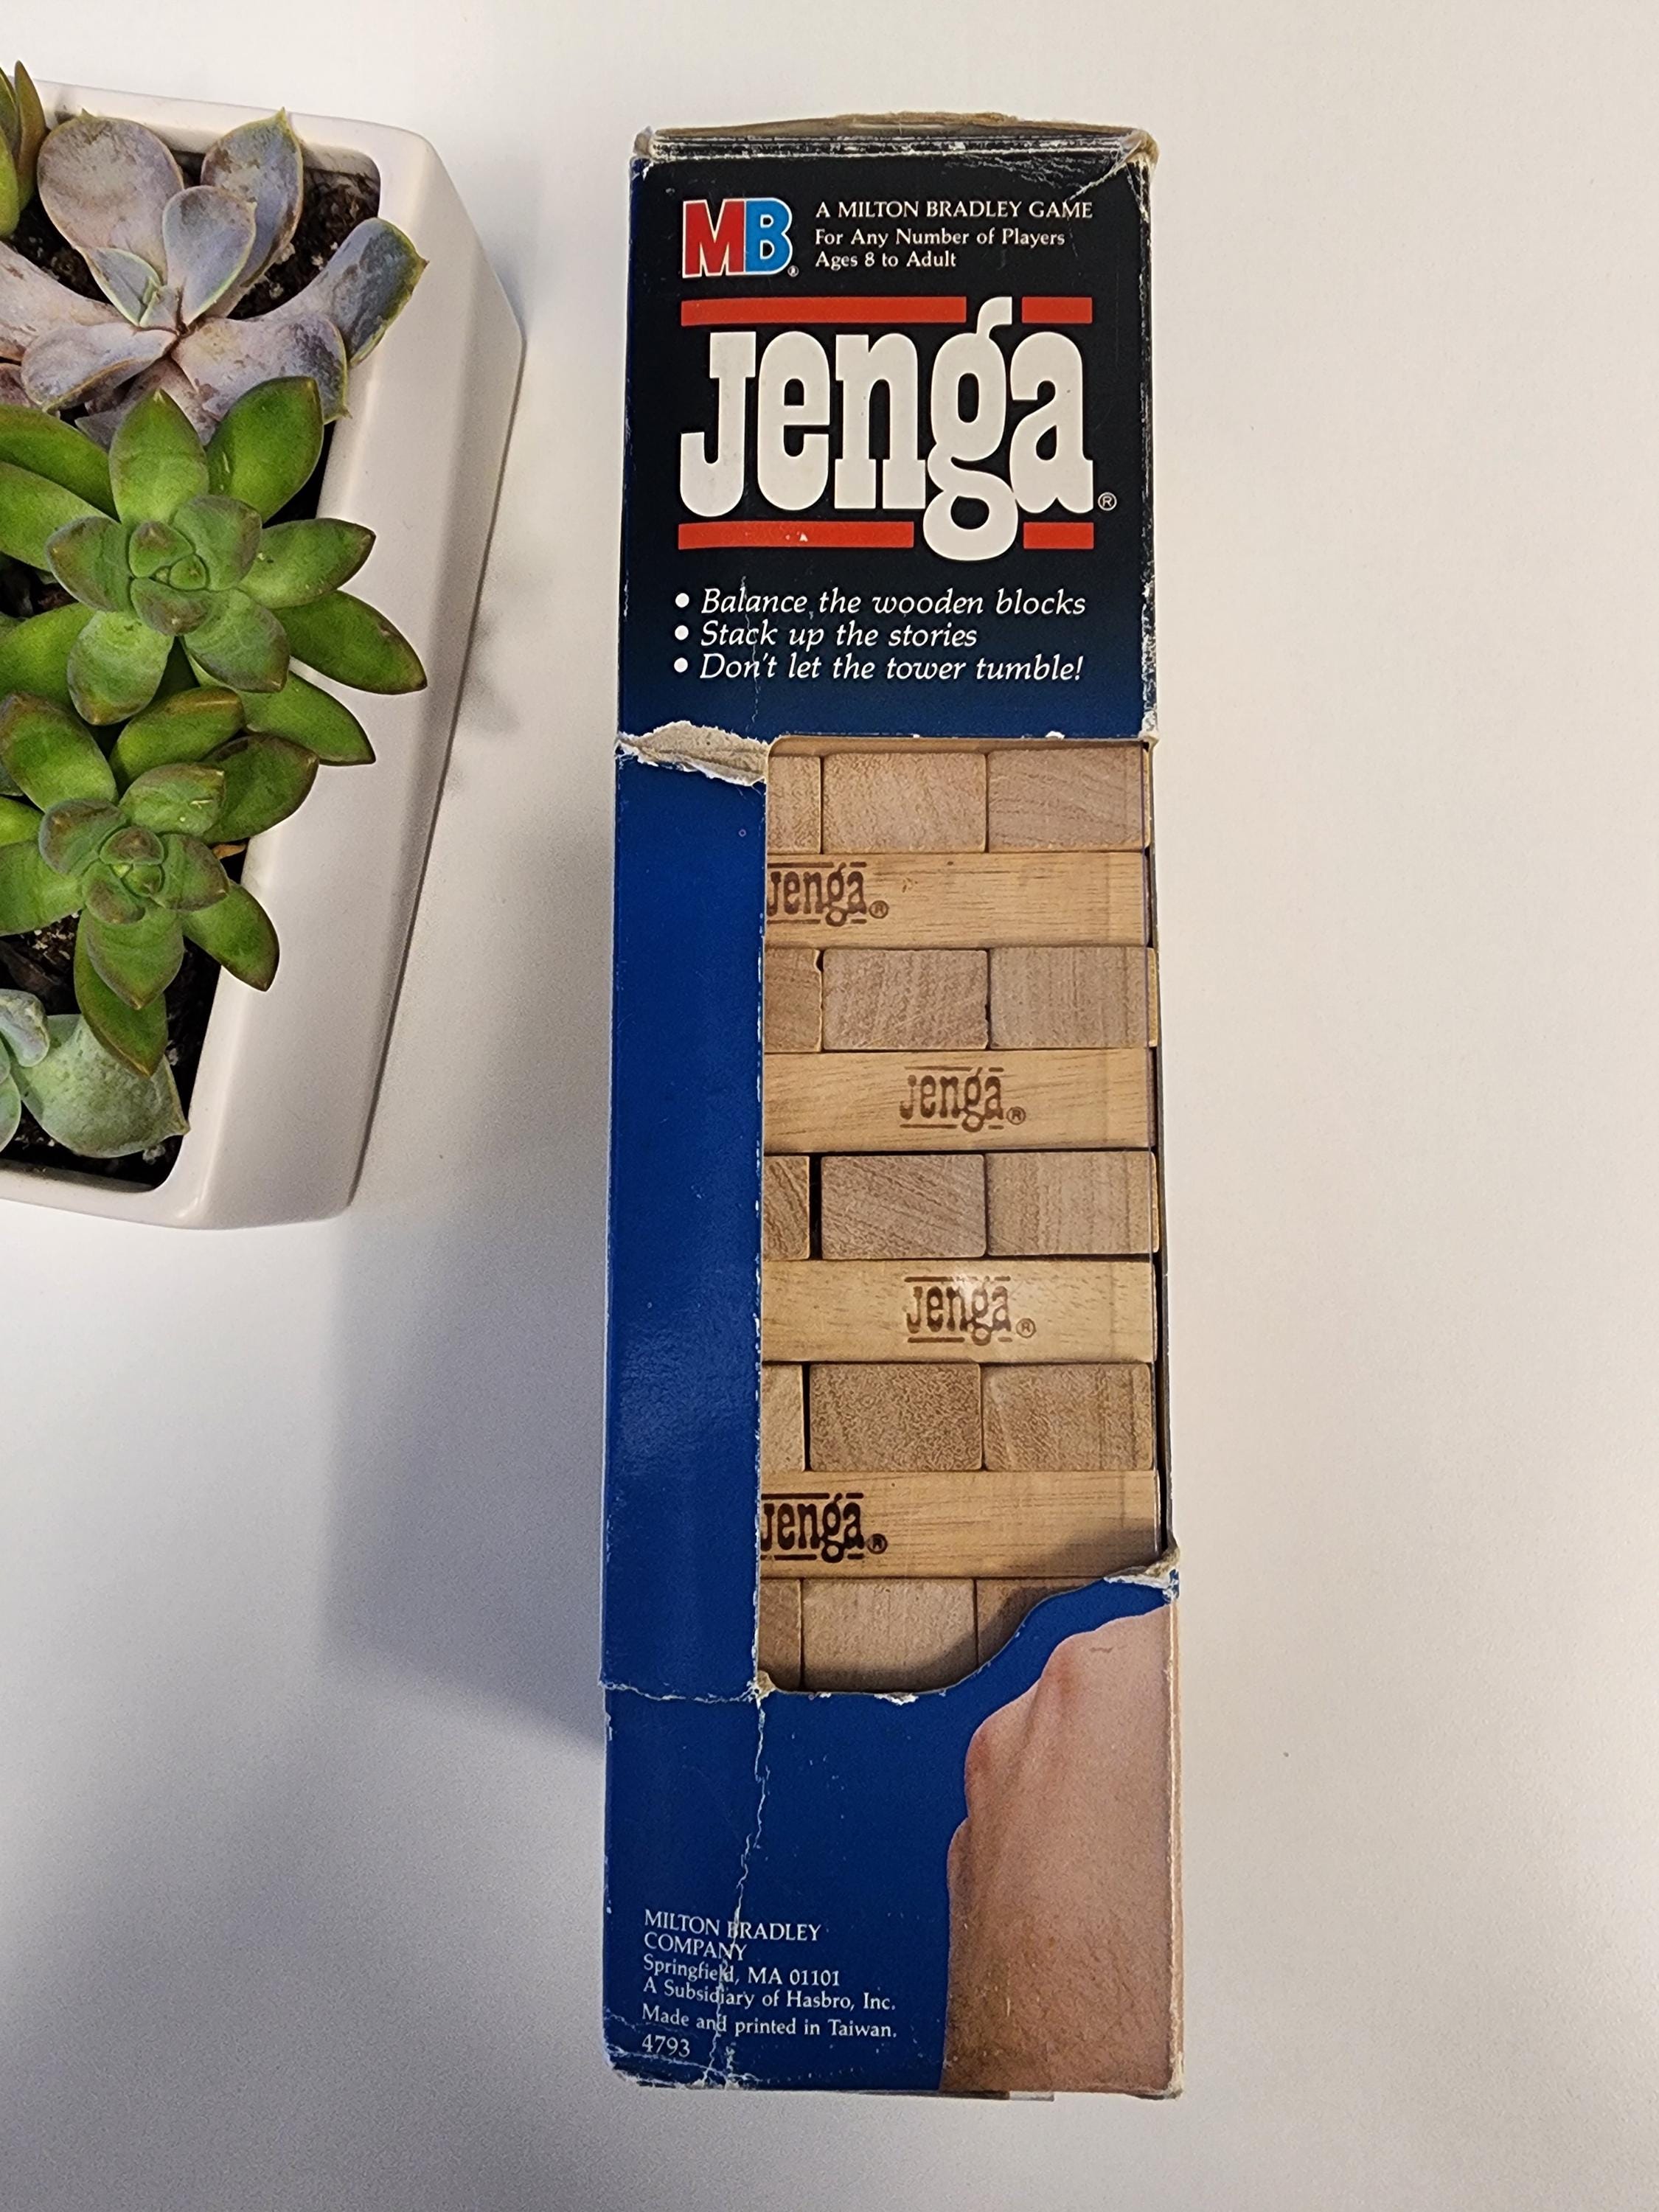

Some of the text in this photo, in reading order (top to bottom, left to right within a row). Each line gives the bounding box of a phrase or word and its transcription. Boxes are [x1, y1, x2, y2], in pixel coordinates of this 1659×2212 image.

[815, 201, 1093, 219] A MILTON BRADLEY GAME
[683, 198, 793, 277] MB
[815, 228, 1065, 249] For Any Number of Players
[815, 251, 957, 271] Ages 8 to Adult
[680, 296, 1093, 560] Jenga
[701, 589, 1086, 615] Balance the wooden blocks
[700, 621, 978, 653] Stack up the stories
[699, 653, 1084, 681] Don't let the tower tumble!
[766, 861, 868, 927] Jenga
[900, 1066, 1005, 1133] Jenga
[905, 1275, 1012, 1346] Jenga
[760, 1492, 865, 1564] Jenga
[644, 1908, 821, 1941] MILTON BRADLEY
[644, 1932, 748, 1961] COMPANY
[643, 1953, 840, 1987] Springfield, MA 01101
[643, 1977, 897, 2011] A Subsidiary of Hasbro, Inc.
[641, 2003, 897, 2038] Made and printed in Taiwan.
[641, 2034, 691, 2058] 4793
